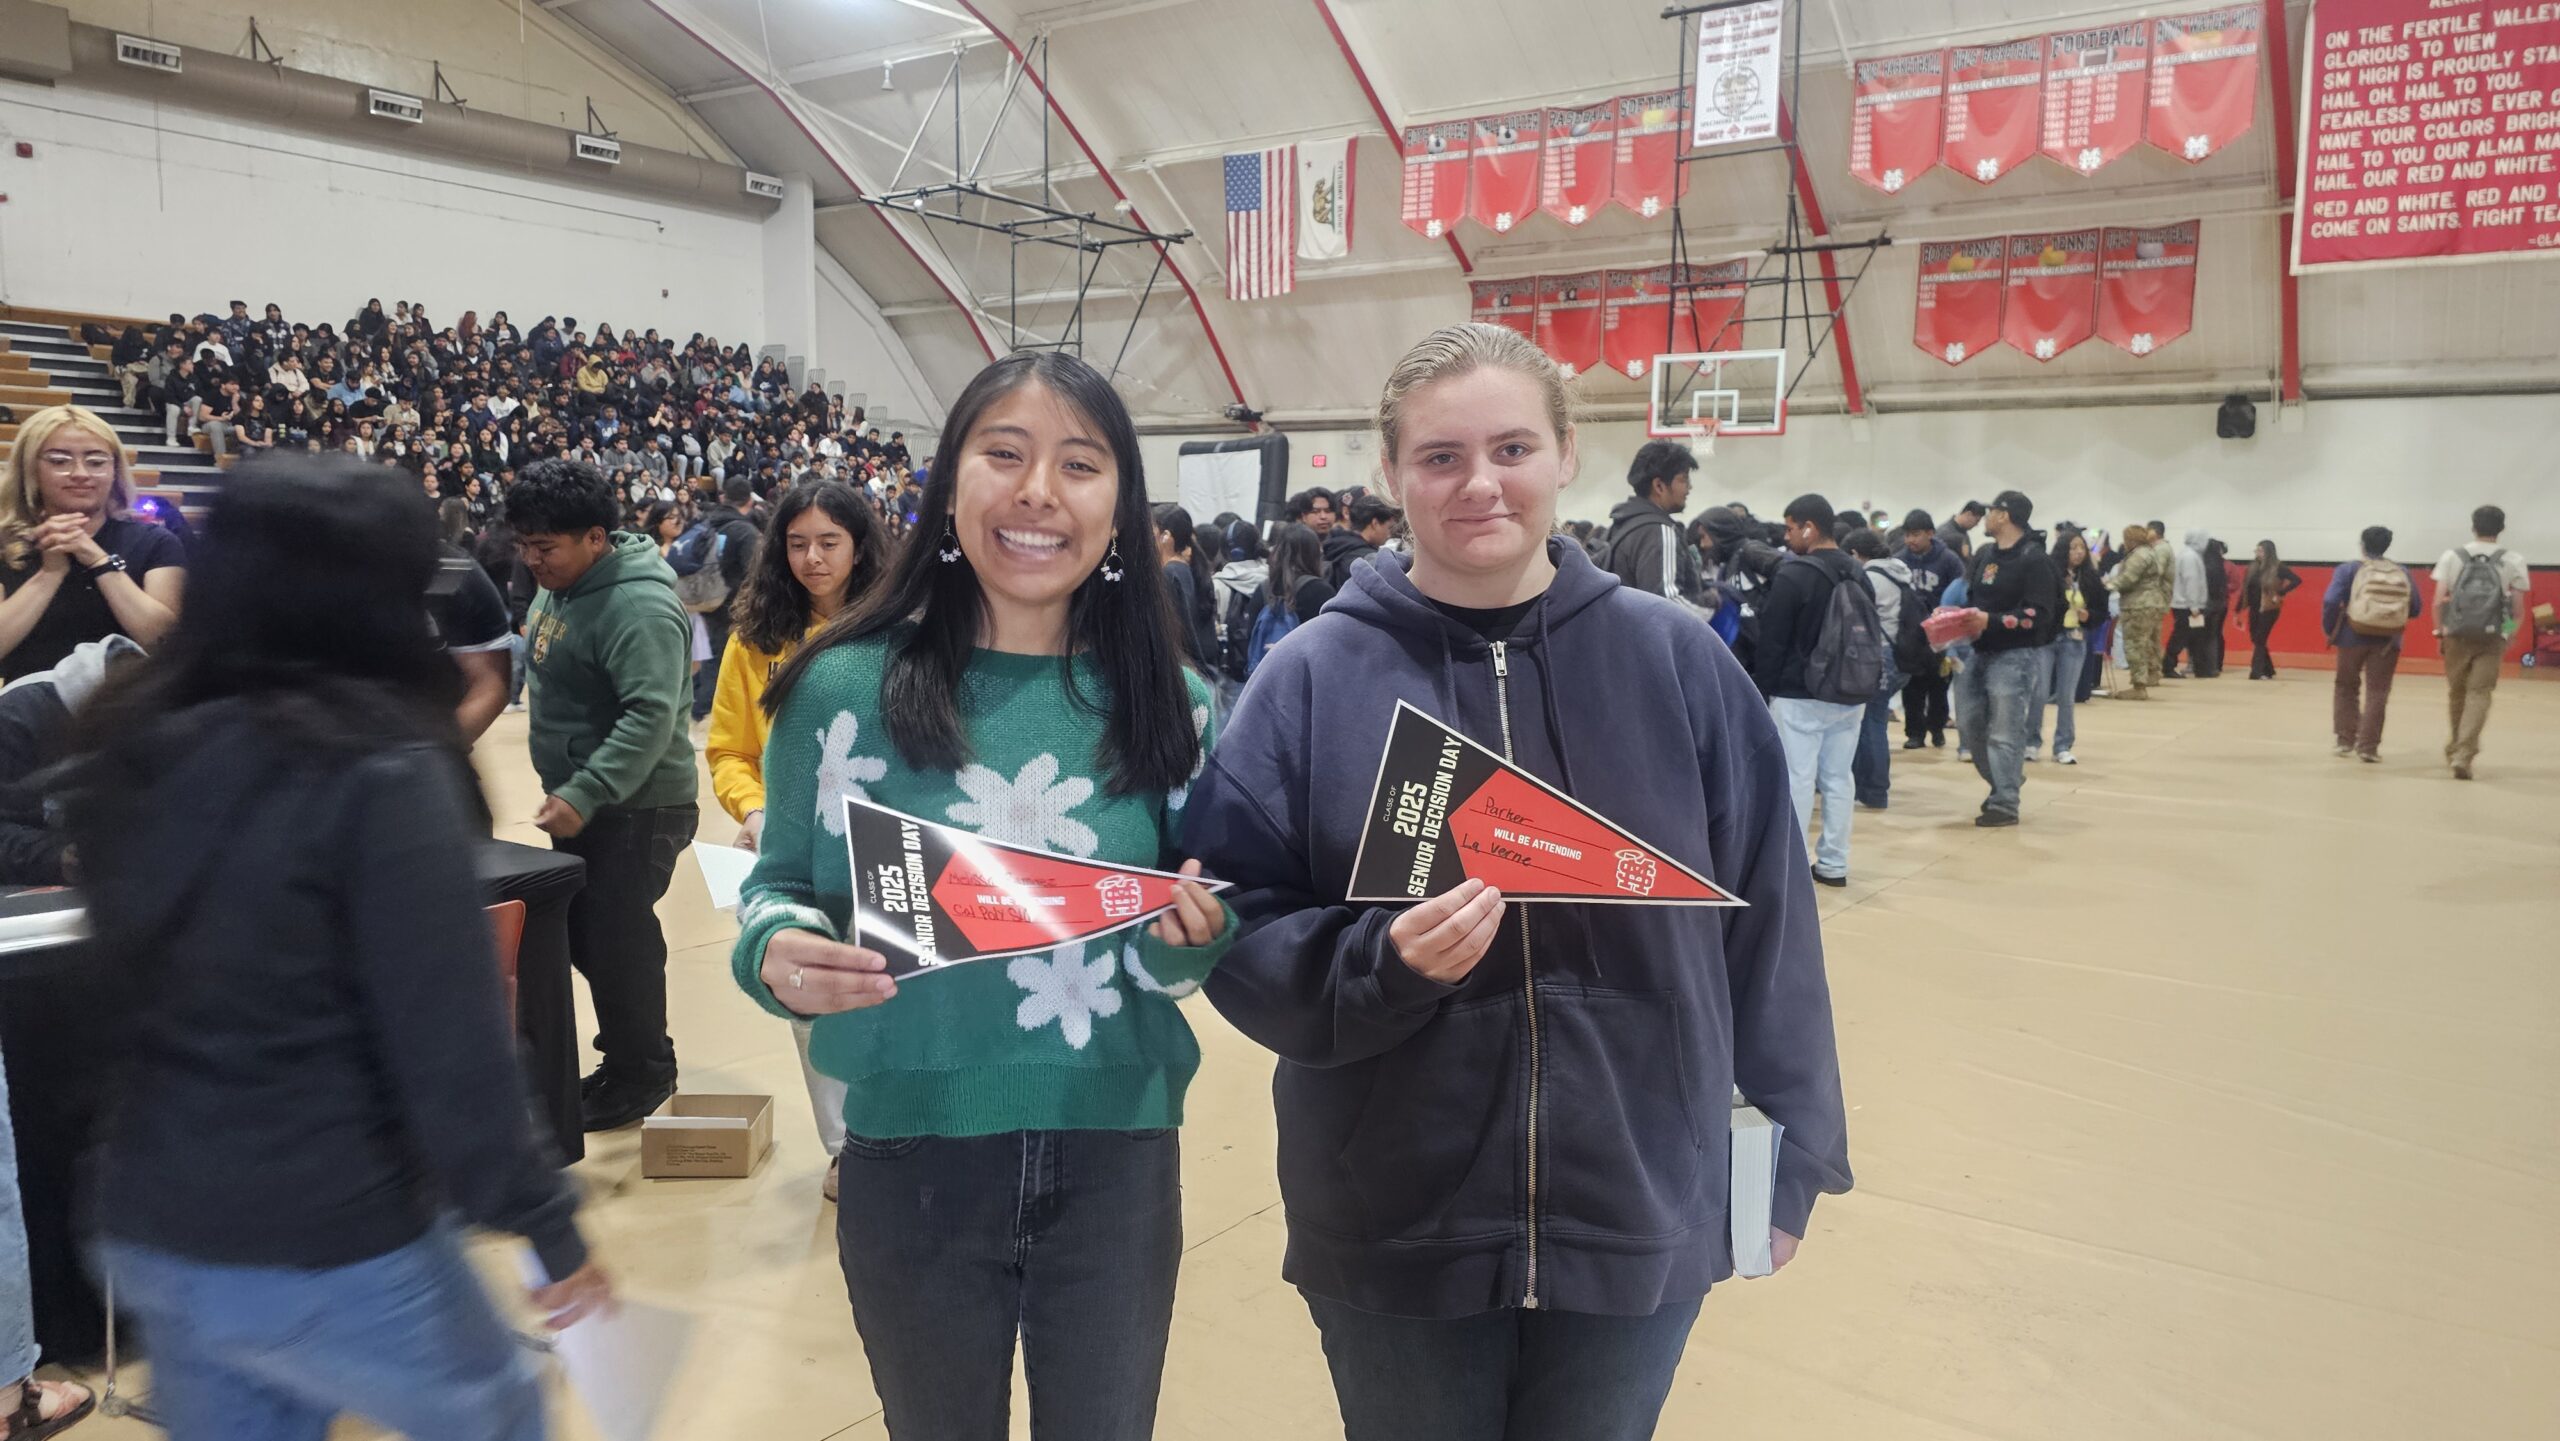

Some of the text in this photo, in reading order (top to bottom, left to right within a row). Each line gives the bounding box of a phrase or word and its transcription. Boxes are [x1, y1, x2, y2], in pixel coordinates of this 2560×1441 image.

[2051, 23, 2145, 59] FOOTBALL
[2325, 30, 2350, 50] ON
[2358, 25, 2394, 45] THE
[2403, 12, 2481, 40] FERTILE
[2323, 45, 2560, 90] SM HIGH IS PROUDLY STA
[2324, 32, 2497, 70] GLORIOUS TO VIEW
[2319, 106, 2411, 130] FEARLESS
[2419, 98, 2482, 121] SAINTS
[2492, 90, 2543, 112] EVER
[2321, 90, 2361, 111] HAIL
[2404, 81, 2445, 102] HAIL
[2453, 77, 2477, 95] TO
[2319, 130, 2363, 151] WAVE
[2371, 125, 2416, 146] YOUR
[2424, 117, 2496, 140] COLORS
[2316, 153, 2355, 172] HAIL
[2361, 150, 2384, 168] TO
[2392, 146, 2426, 165] YOU
[2433, 141, 2470, 161] OUR
[2476, 135, 2525, 157] ALMA
[2363, 168, 2399, 188] OUR
[2407, 164, 2445, 184] RED
[2451, 160, 2487, 180] AND
[2313, 200, 2348, 218] RED
[2353, 197, 2389, 216] AND
[2466, 187, 2501, 208] RED
[2508, 184, 2547, 204] AND
[2311, 219, 2360, 239] COME
[2365, 217, 2391, 235] ON
[2472, 206, 2525, 228] FIGHT
[1383, 785, 1397, 823] CLASS OF
[1393, 780, 1428, 838] 2025
[1407, 735, 1462, 897] SENIOR DECISION DAY
[1485, 796, 1534, 824] Parker
[1462, 833, 1480, 854] La
[1494, 828, 1583, 861] WILL BE ATTENDING
[867, 870, 874, 880] OF
[878, 864, 909, 913] 2025
[901, 819, 938, 967] SENIOR DECISION DAY
[976, 894, 998, 905] WILL
